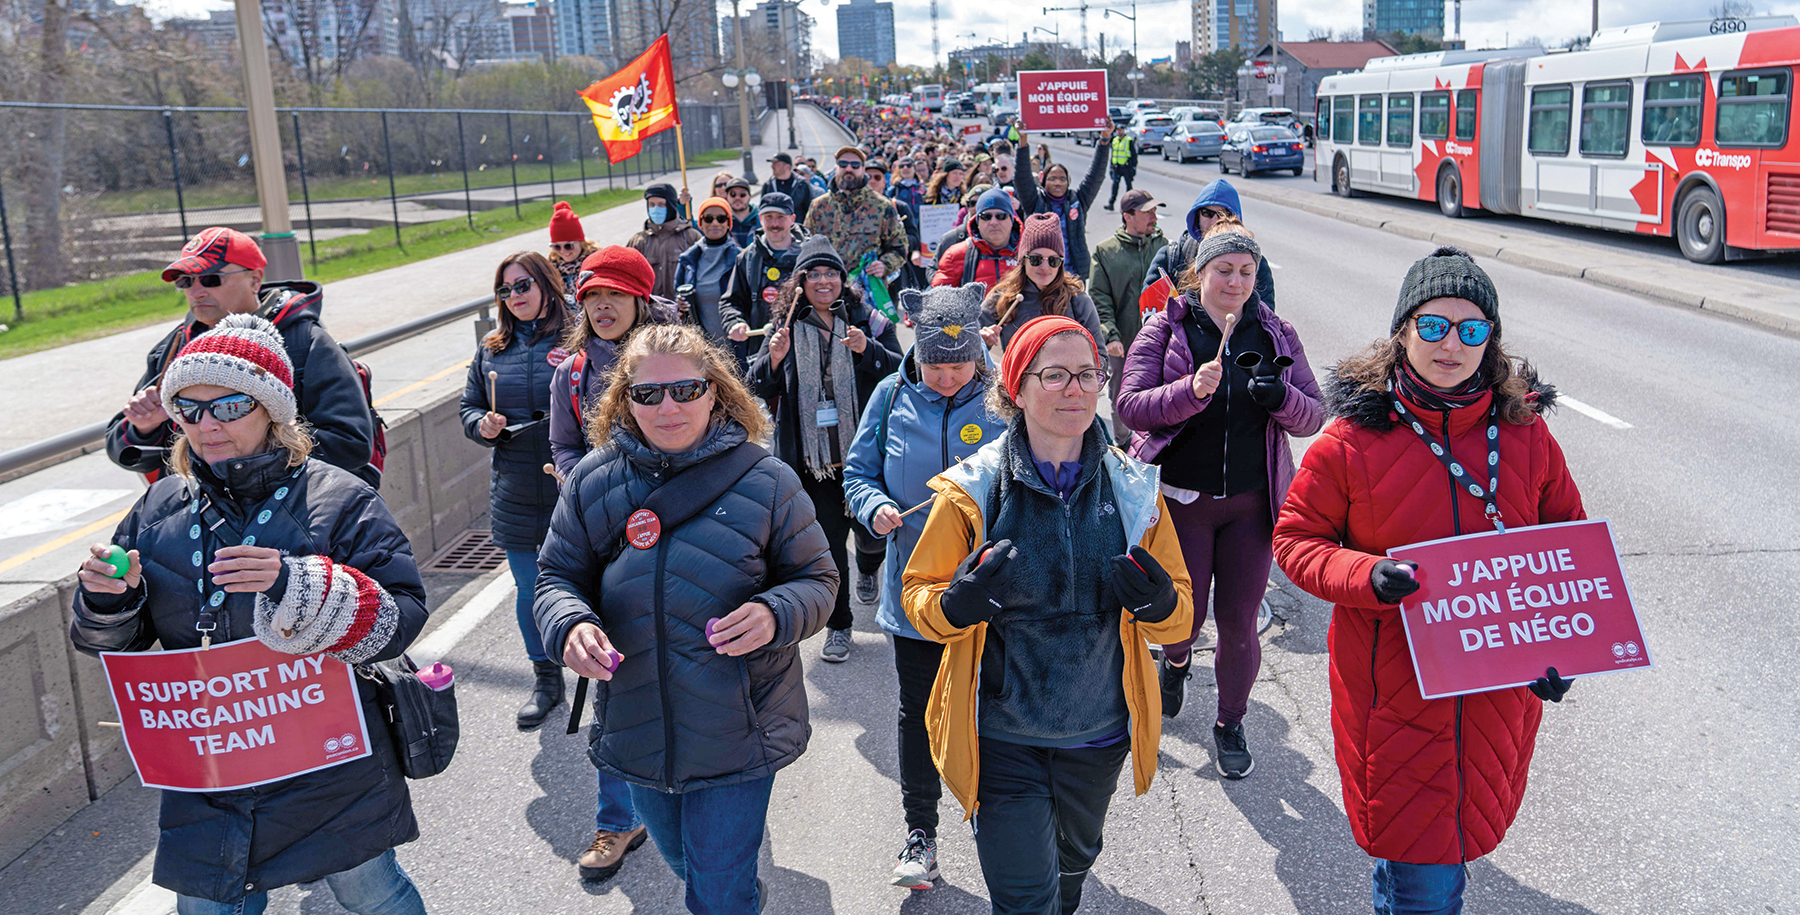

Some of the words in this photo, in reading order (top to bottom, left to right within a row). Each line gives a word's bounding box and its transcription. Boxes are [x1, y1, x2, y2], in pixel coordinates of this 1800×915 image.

[1709, 20, 1747, 35] 6490
[1028, 94, 1054, 103] MON
[1056, 91, 1099, 103] ÉQUIPE
[1037, 81, 1088, 91] J'APPUIE
[1039, 105, 1055, 114] DE
[1057, 103, 1089, 113] NÉGO
[1712, 151, 1752, 171] Transpo
[1447, 548, 1576, 587] J'APPUIE
[1421, 591, 1502, 625] MON
[1506, 577, 1613, 612] ÉQUIPE
[1459, 625, 1505, 652] DE
[1508, 612, 1596, 645] NÉGO
[125, 682, 136, 701] I
[138, 667, 270, 703] SUPPORT
[277, 653, 326, 684] MY
[139, 683, 326, 729] BARGAINING
[188, 724, 276, 756] TEAM
